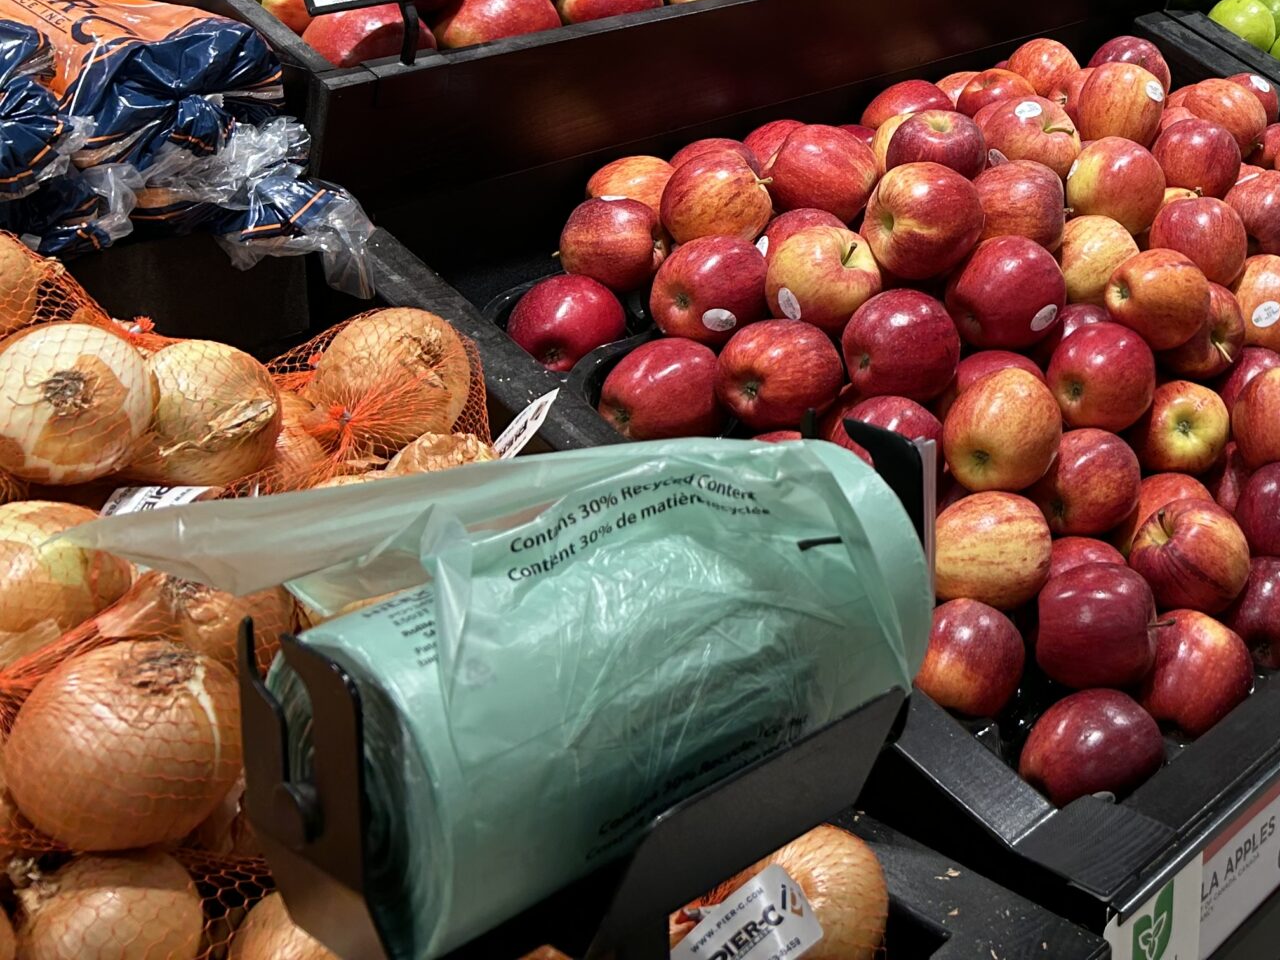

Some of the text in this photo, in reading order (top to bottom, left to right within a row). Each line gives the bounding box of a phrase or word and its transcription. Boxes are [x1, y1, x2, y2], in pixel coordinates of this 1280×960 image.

[578, 492, 619, 520] 30%
[579, 524, 614, 551] 30%
[615, 511, 638, 530] de
[1223, 815, 1276, 882] APPLES
[690, 886, 766, 953] WWW.PIER-C.COM
[707, 903, 785, 960] PIER-C
